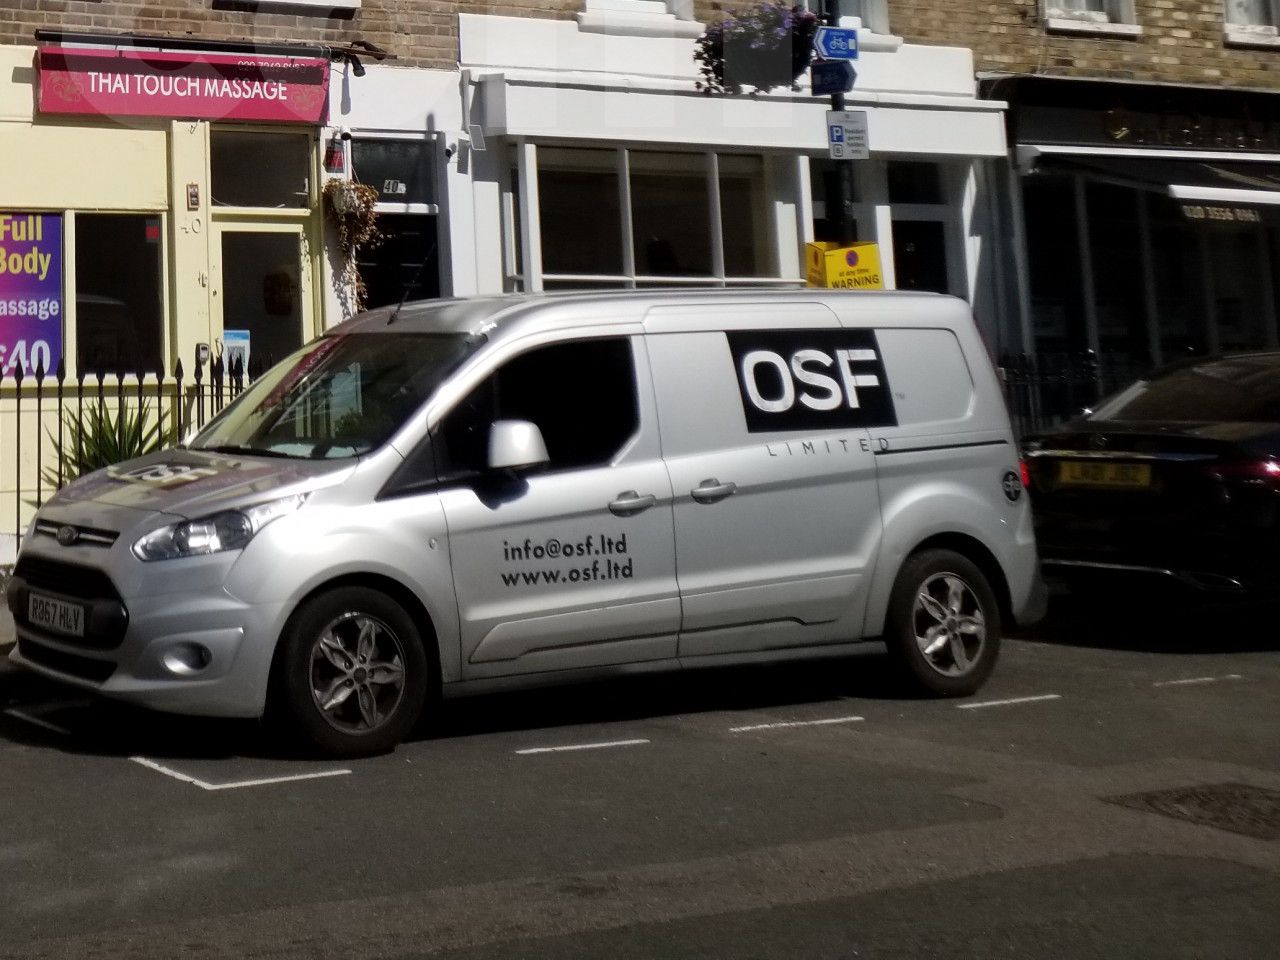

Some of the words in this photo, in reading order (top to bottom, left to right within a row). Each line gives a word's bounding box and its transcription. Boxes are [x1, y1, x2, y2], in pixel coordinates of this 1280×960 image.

[87, 71, 130, 95] THAI
[133, 73, 200, 97] TOUCH
[204, 76, 288, 101] MASSAGE
[385, 180, 399, 193] 40
[832, 274, 879, 289] WARNING
[743, 348, 880, 413] OSF
[766, 437, 890, 457] LIMITED
[503, 532, 627, 561] info@osf.ltd
[501, 558, 633, 587] www.osf.ltd
